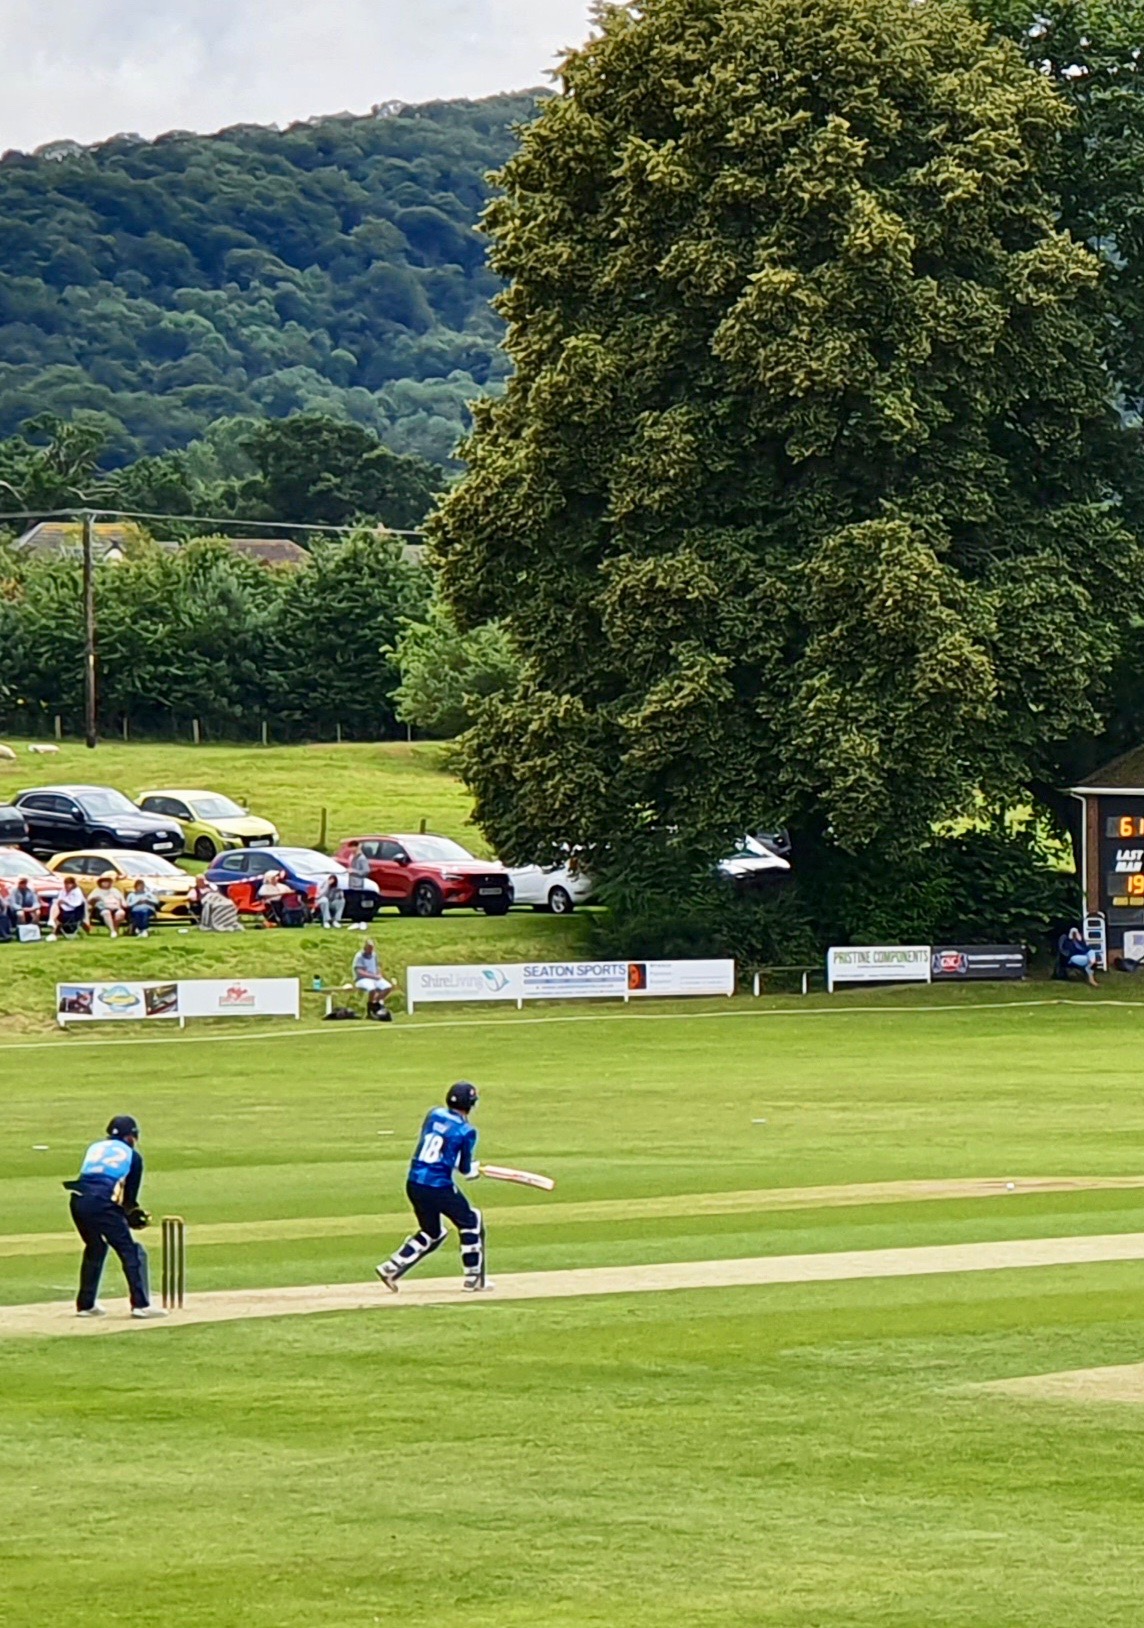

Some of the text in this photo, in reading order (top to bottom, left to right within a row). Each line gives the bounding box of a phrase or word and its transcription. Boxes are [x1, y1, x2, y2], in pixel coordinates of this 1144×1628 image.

[1116, 850, 1144, 861] LAST
[1115, 861, 1142, 873] MAN
[833, 950, 871, 964] PRISTINE
[873, 949, 928, 963] COMPONENTS
[523, 963, 626, 978] SEATON SPORTS
[418, 1132, 444, 1164] 18
